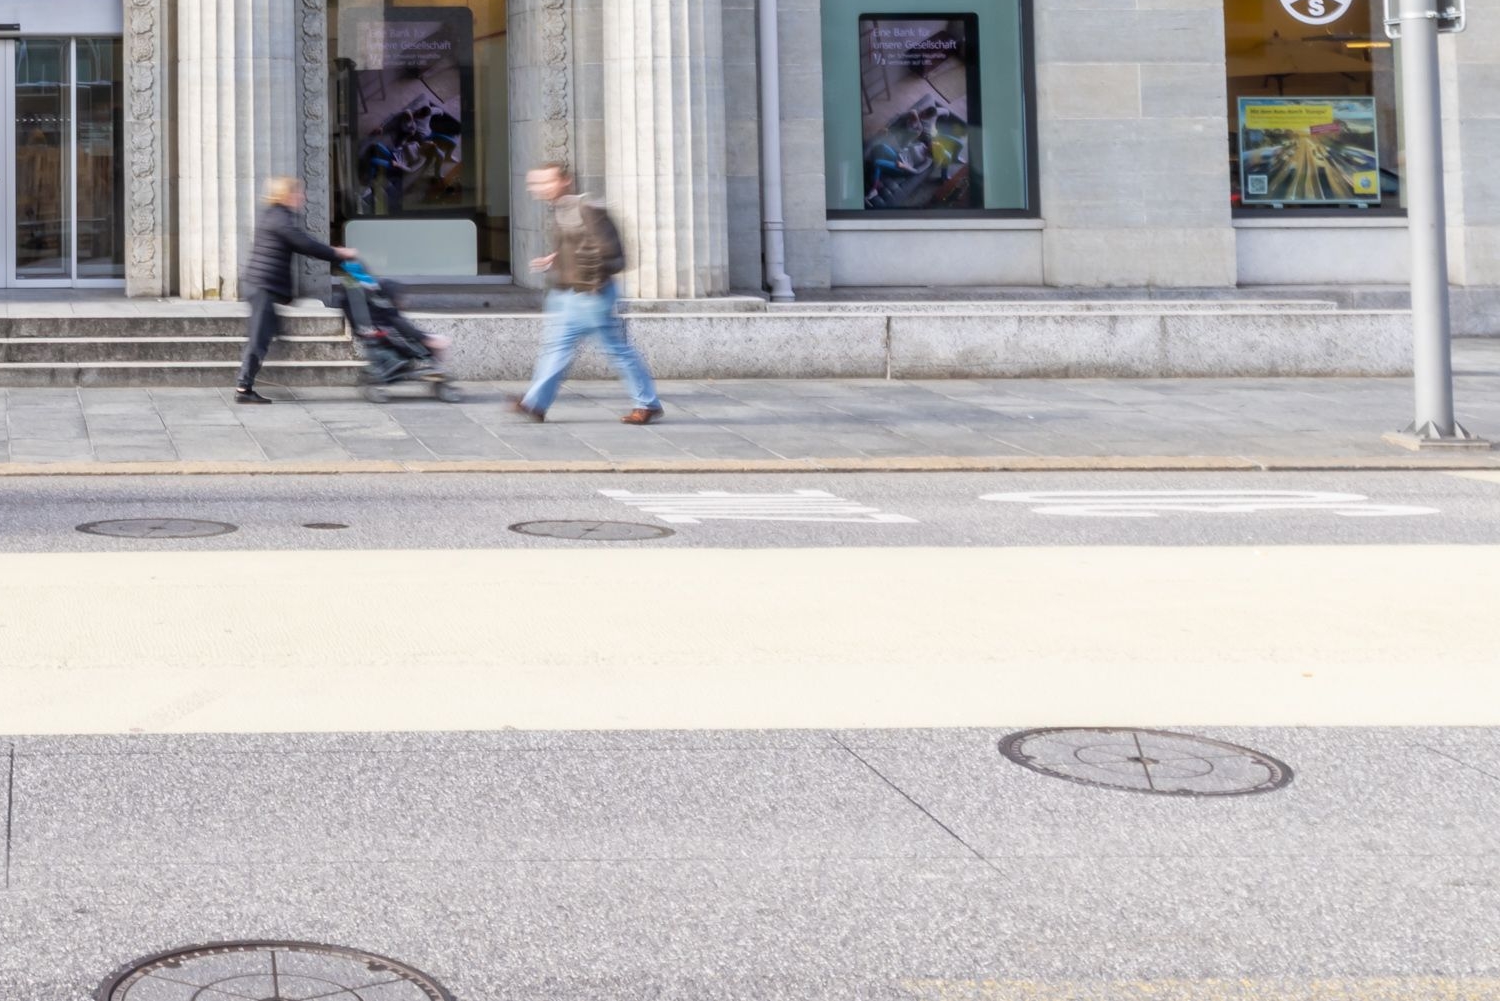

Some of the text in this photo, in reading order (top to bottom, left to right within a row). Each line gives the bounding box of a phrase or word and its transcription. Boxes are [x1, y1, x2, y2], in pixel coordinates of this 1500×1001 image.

[873, 28, 891, 37] Eine
[893, 27, 915, 37] Bank
[401, 40, 452, 50] Gesellschaft
[873, 39, 957, 49] unsere Gesellschaft
[597, 489, 921, 524] ZONE
[978, 490, 1441, 518] 30
